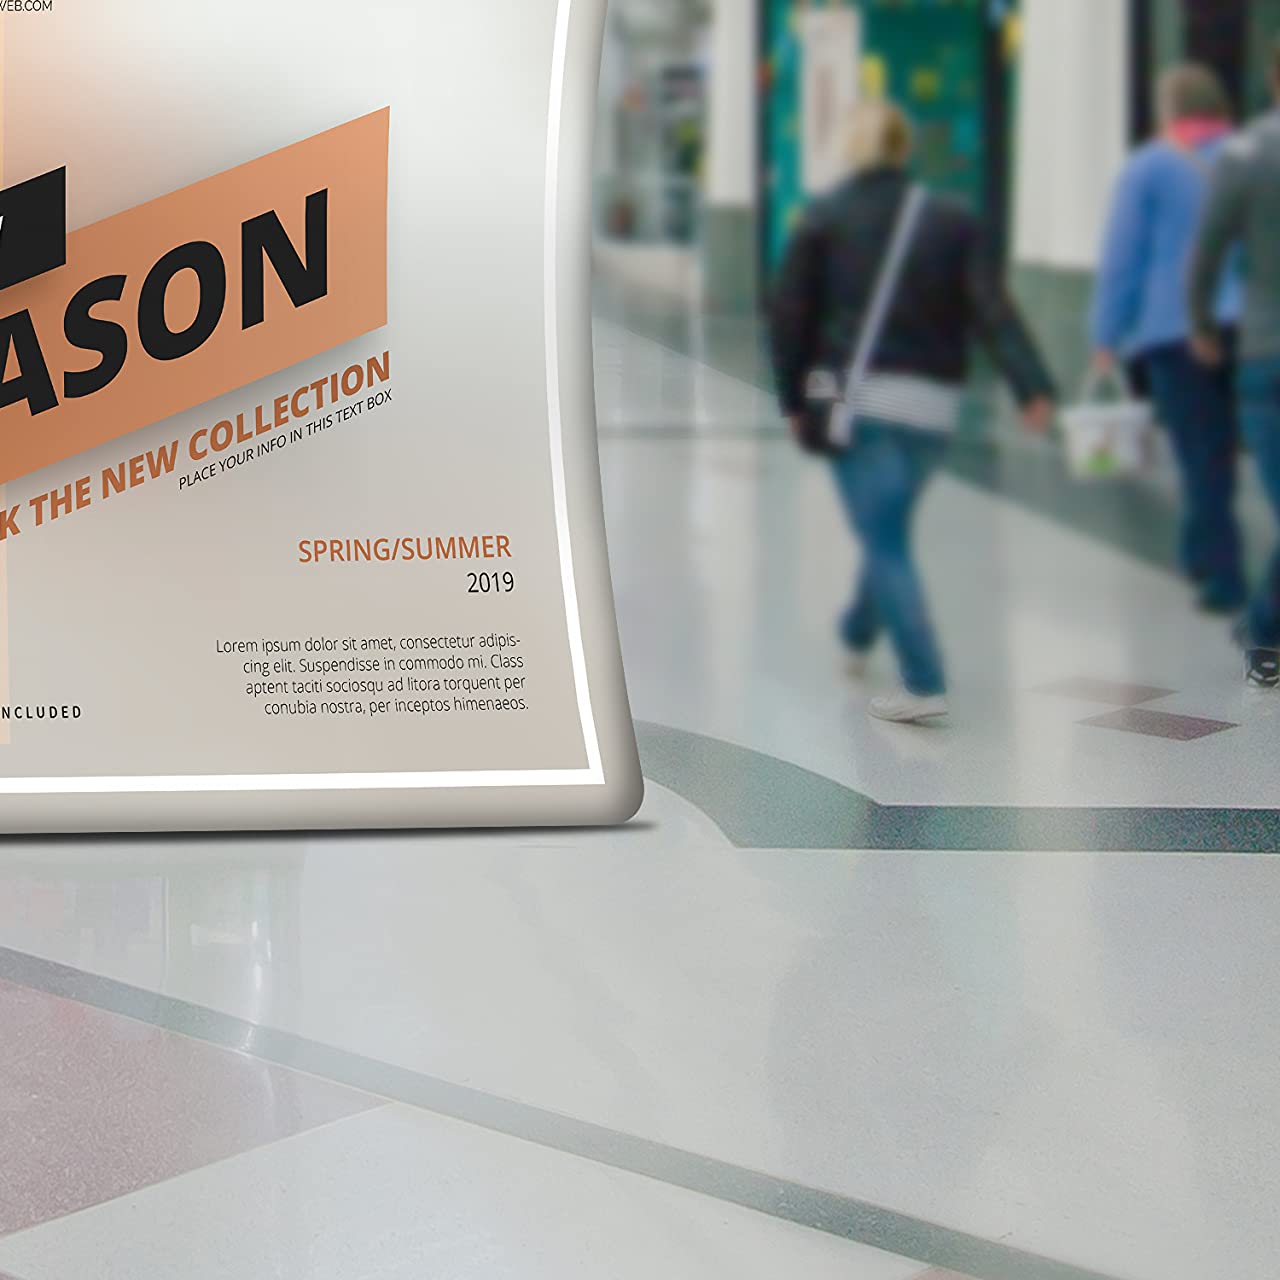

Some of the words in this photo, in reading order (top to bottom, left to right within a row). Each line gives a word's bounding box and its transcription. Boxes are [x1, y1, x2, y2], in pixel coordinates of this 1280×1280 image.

[28, 475, 91, 527] THE
[101, 439, 179, 500] NEW
[188, 350, 390, 461] COLLECTION
[178, 463, 216, 490] PLACE
[218, 448, 254, 472] YOUR
[257, 434, 287, 457] INFO
[290, 427, 303, 444] IN
[305, 414, 333, 436] THIS
[335, 401, 364, 423] TEXT
[367, 388, 392, 411] BOX
[298, 535, 512, 563] SPRING/SUMMER
[467, 572, 514, 593] 2019
[216, 639, 258, 653] Lorem
[262, 638, 301, 656] ipsum
[304, 637, 338, 651] dolor
[342, 637, 357, 651] sit
[360, 636, 396, 651] amet,
[399, 635, 475, 650] consectetur
[479, 632, 521, 651] adipis-
[243, 659, 270, 677] cing
[273, 659, 296, 673] elit.
[299, 657, 380, 675] Suspendisse
[383, 656, 396, 670] in
[398, 655, 464, 671] commodo
[467, 654, 487, 669] mi.
[490, 653, 524, 669] Class
[245, 681, 289, 698] aptent
[292, 679, 322, 694] taciti
[326, 678, 383, 695] sociosqu
[387, 677, 403, 692] ad
[407, 676, 441, 691] litora
[443, 676, 501, 694] torquent
[504, 676, 526, 693] per
[264, 699, 317, 715] conubia
[321, 700, 366, 715] nostra,
[369, 700, 391, 717] per
[394, 697, 451, 716] inceptos
[453, 696, 529, 712] himenaeos.
